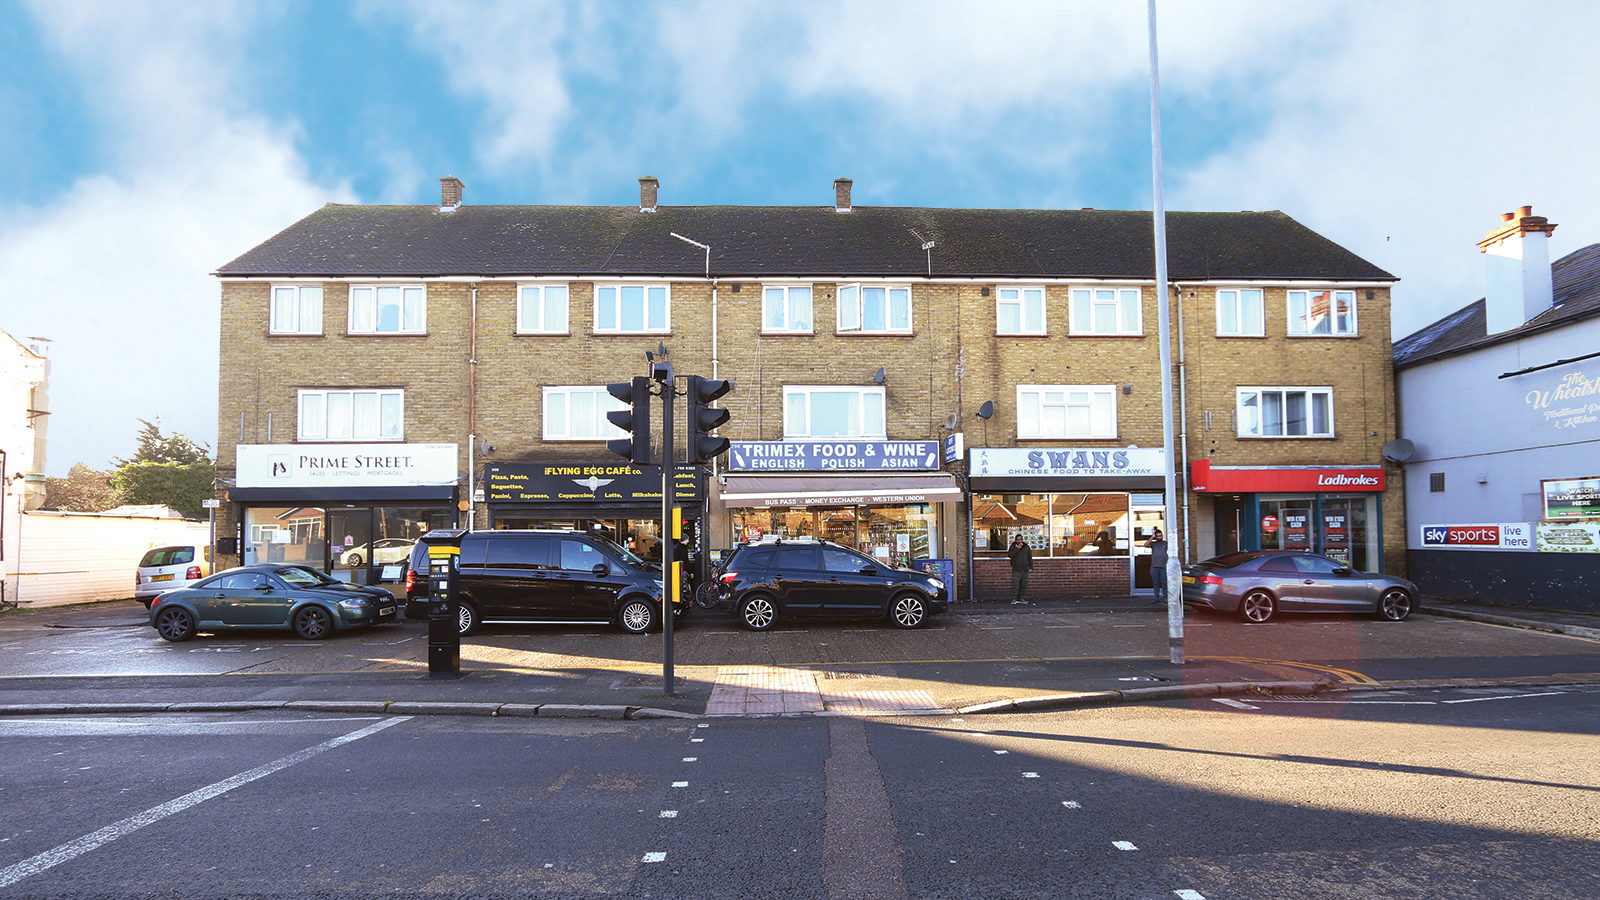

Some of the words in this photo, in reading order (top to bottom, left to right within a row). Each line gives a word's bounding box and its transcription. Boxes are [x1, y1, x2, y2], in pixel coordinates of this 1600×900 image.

[1563, 372, 1586, 389] The
[1544, 404, 1587, 421] Traditional
[1563, 415, 1597, 429] Kitchen
[743, 444, 806, 456] TRIMEX
[813, 444, 857, 456] FOOD
[864, 444, 876, 456] &
[883, 444, 926, 456] WINE
[752, 459, 805, 468] ENGLISH
[822, 459, 865, 468] POLISH
[881, 458, 918, 467] ASIAN
[1028, 451, 1130, 469] SWANS
[583, 467, 604, 475] EGG
[606, 466, 631, 475] CAFÉ
[1318, 474, 1378, 486] Ladbrokes
[1426, 528, 1447, 543] sky
[1450, 528, 1496, 543] sports
[1504, 526, 1522, 535] live
[1504, 536, 1528, 546] here
